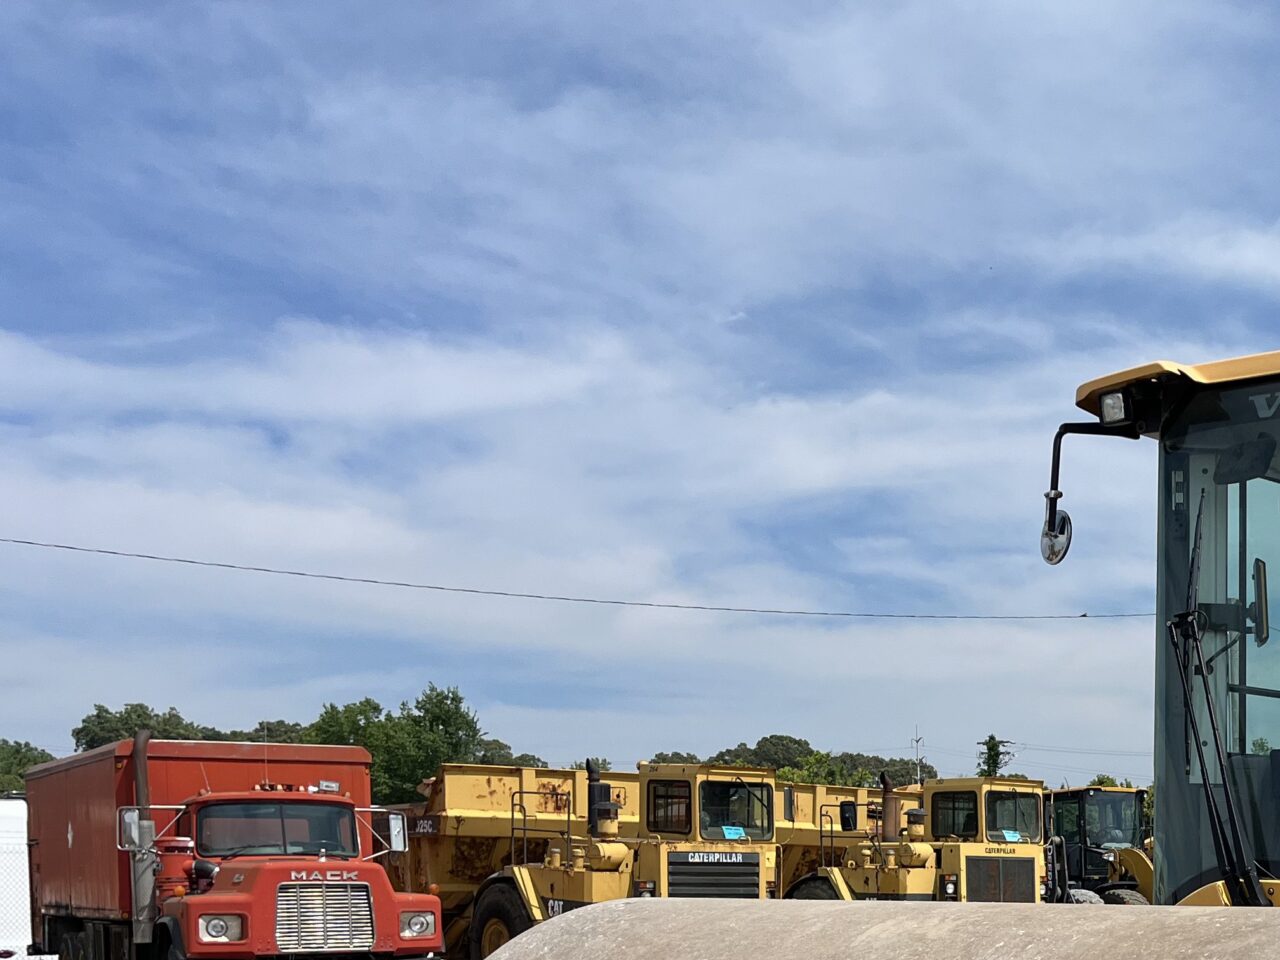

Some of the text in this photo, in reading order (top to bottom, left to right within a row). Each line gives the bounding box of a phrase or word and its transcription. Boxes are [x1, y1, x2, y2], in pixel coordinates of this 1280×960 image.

[688, 852, 743, 863] CATERPILLAR
[290, 870, 359, 880] MACK
[548, 900, 564, 917] CAT
